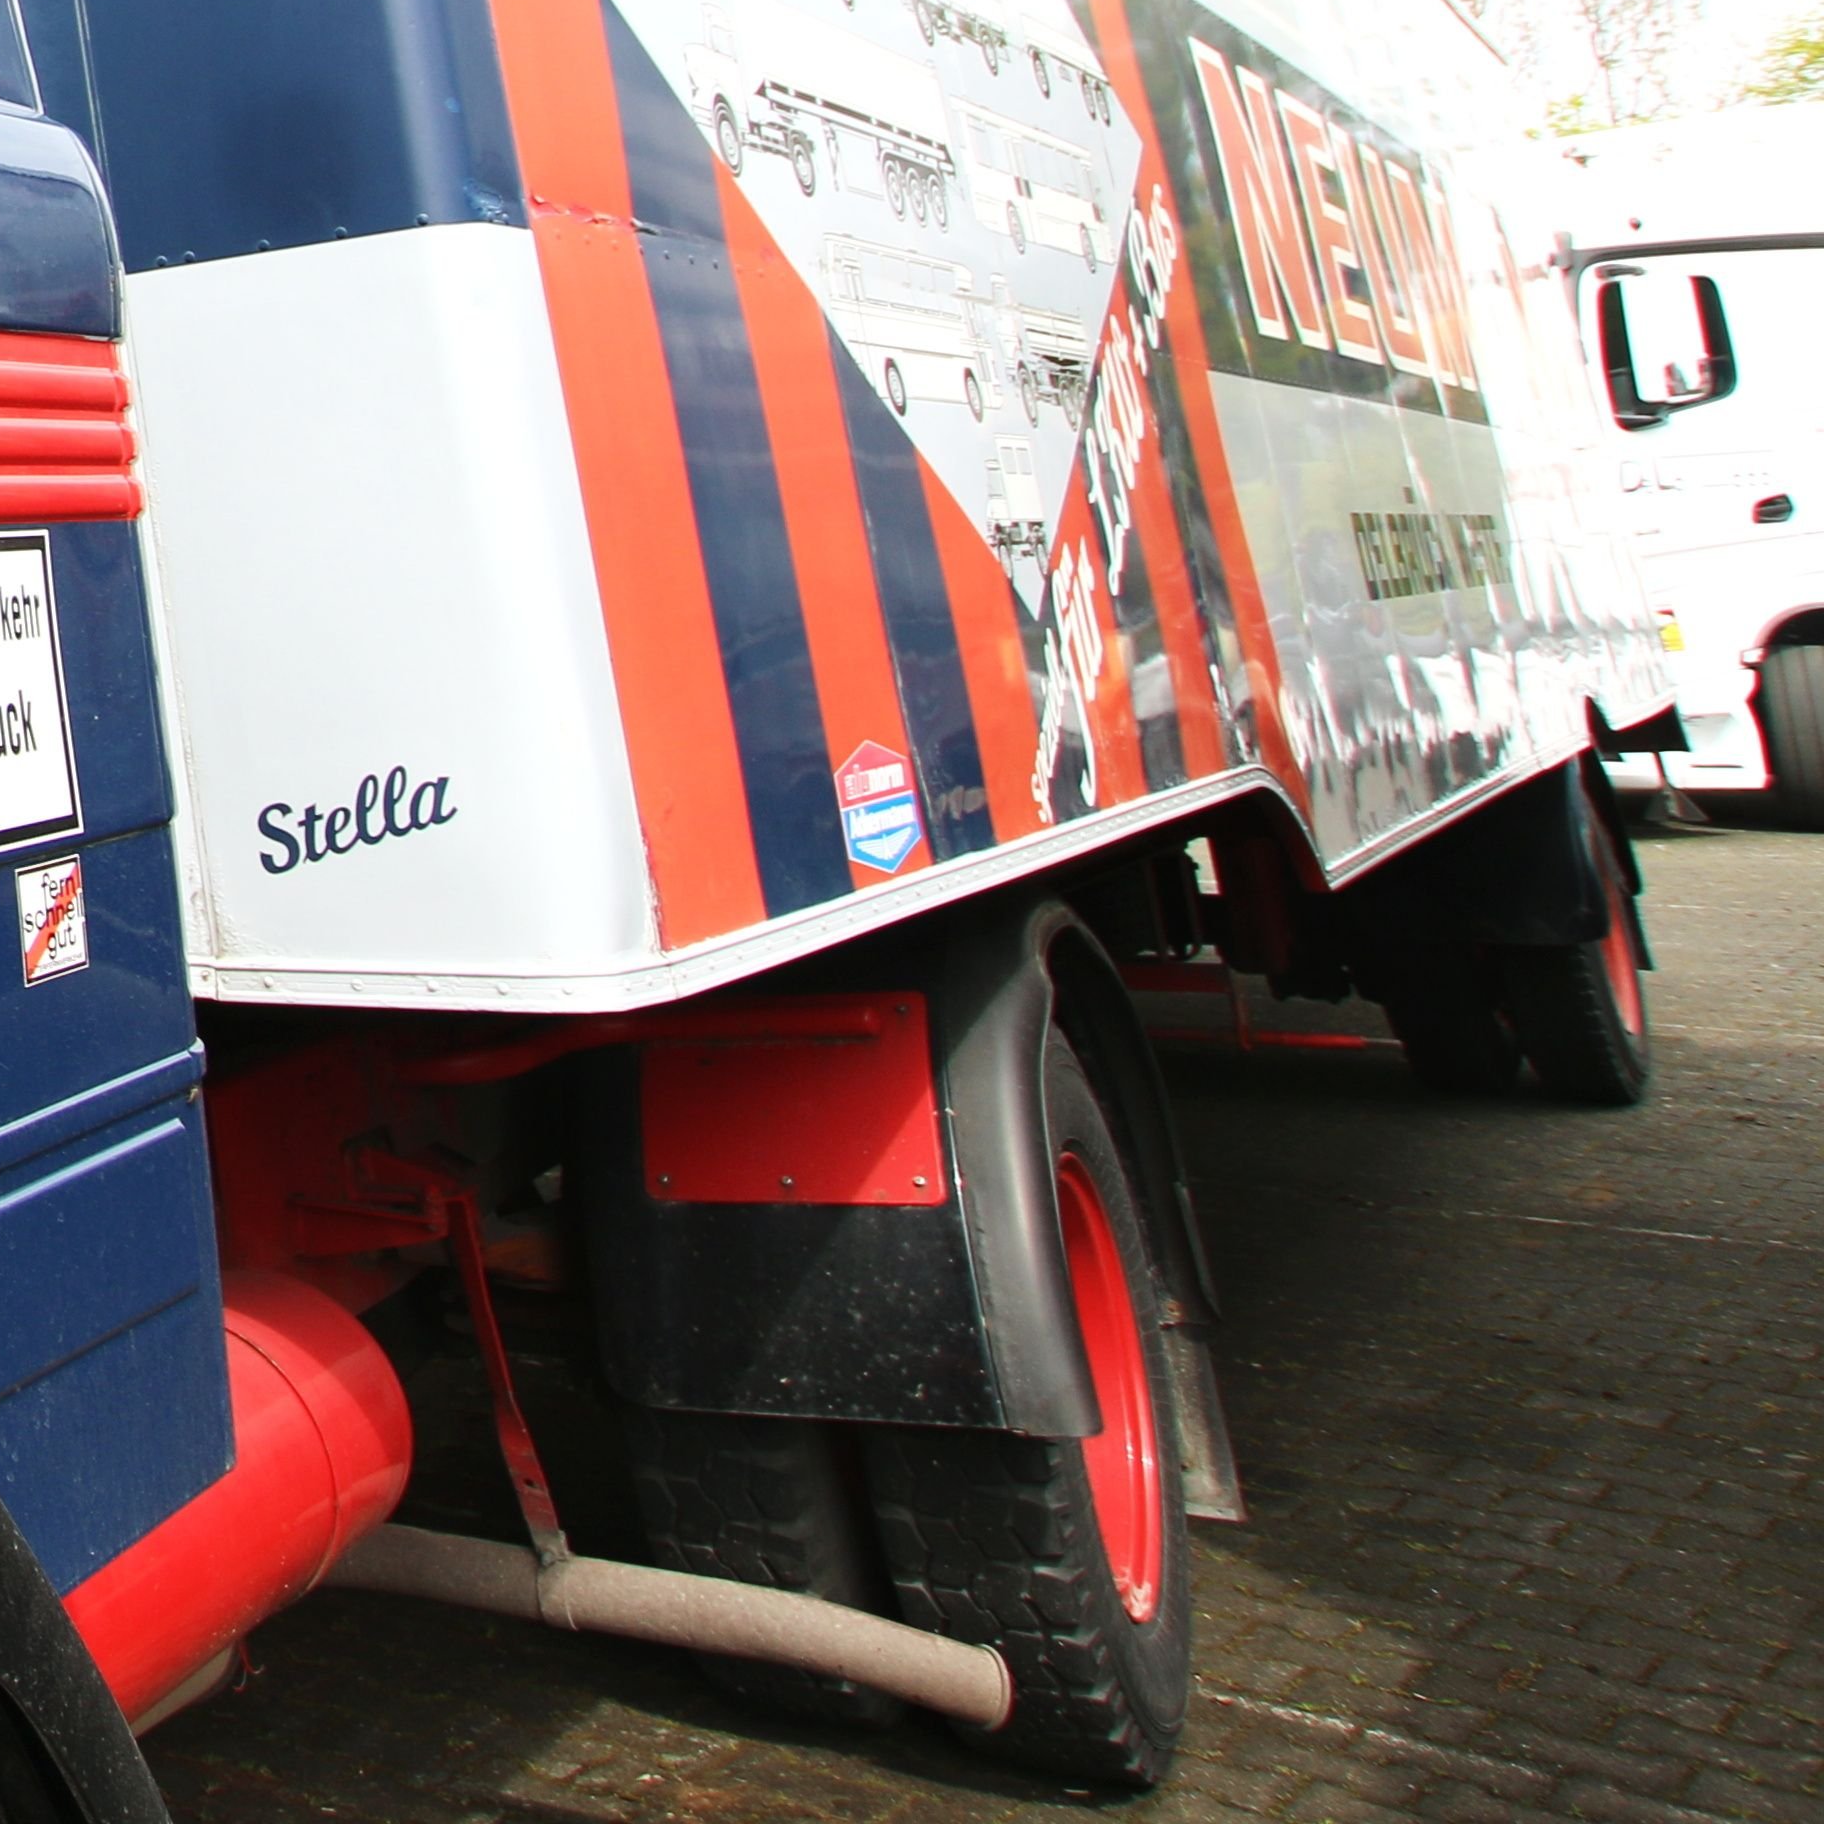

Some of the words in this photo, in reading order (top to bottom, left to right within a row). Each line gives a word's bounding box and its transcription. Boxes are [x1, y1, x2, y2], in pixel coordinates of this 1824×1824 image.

[1127, 182, 1178, 350] Bus
[1188, 36, 1479, 392] NEUM
[257, 765, 458, 874] Stella
[41, 872, 77, 899] fern
[47, 923, 77, 960] gut
